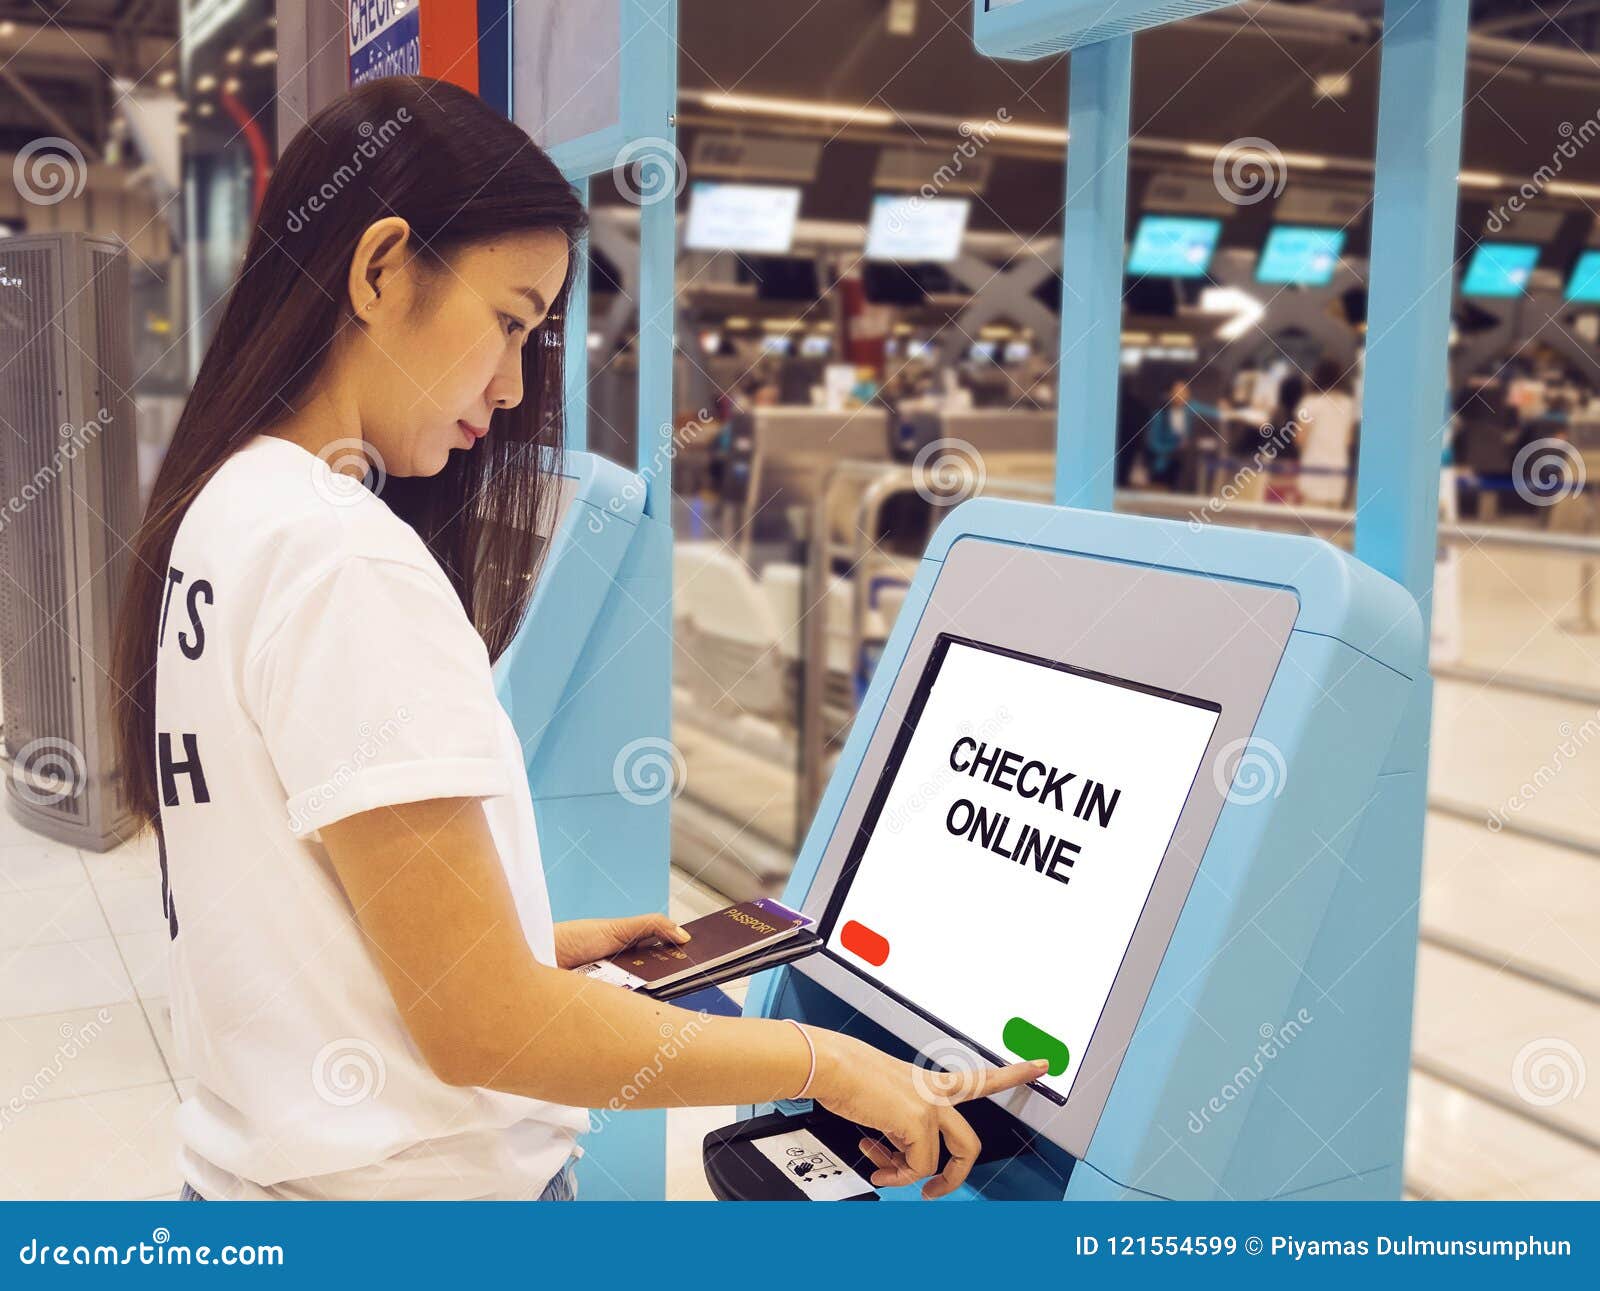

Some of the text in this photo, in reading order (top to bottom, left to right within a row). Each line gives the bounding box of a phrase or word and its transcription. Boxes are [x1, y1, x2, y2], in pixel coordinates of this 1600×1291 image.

[949, 736, 1122, 829] CHECK IN
[946, 798, 1083, 886] ONLINE
[724, 908, 777, 935] PASSPORT
